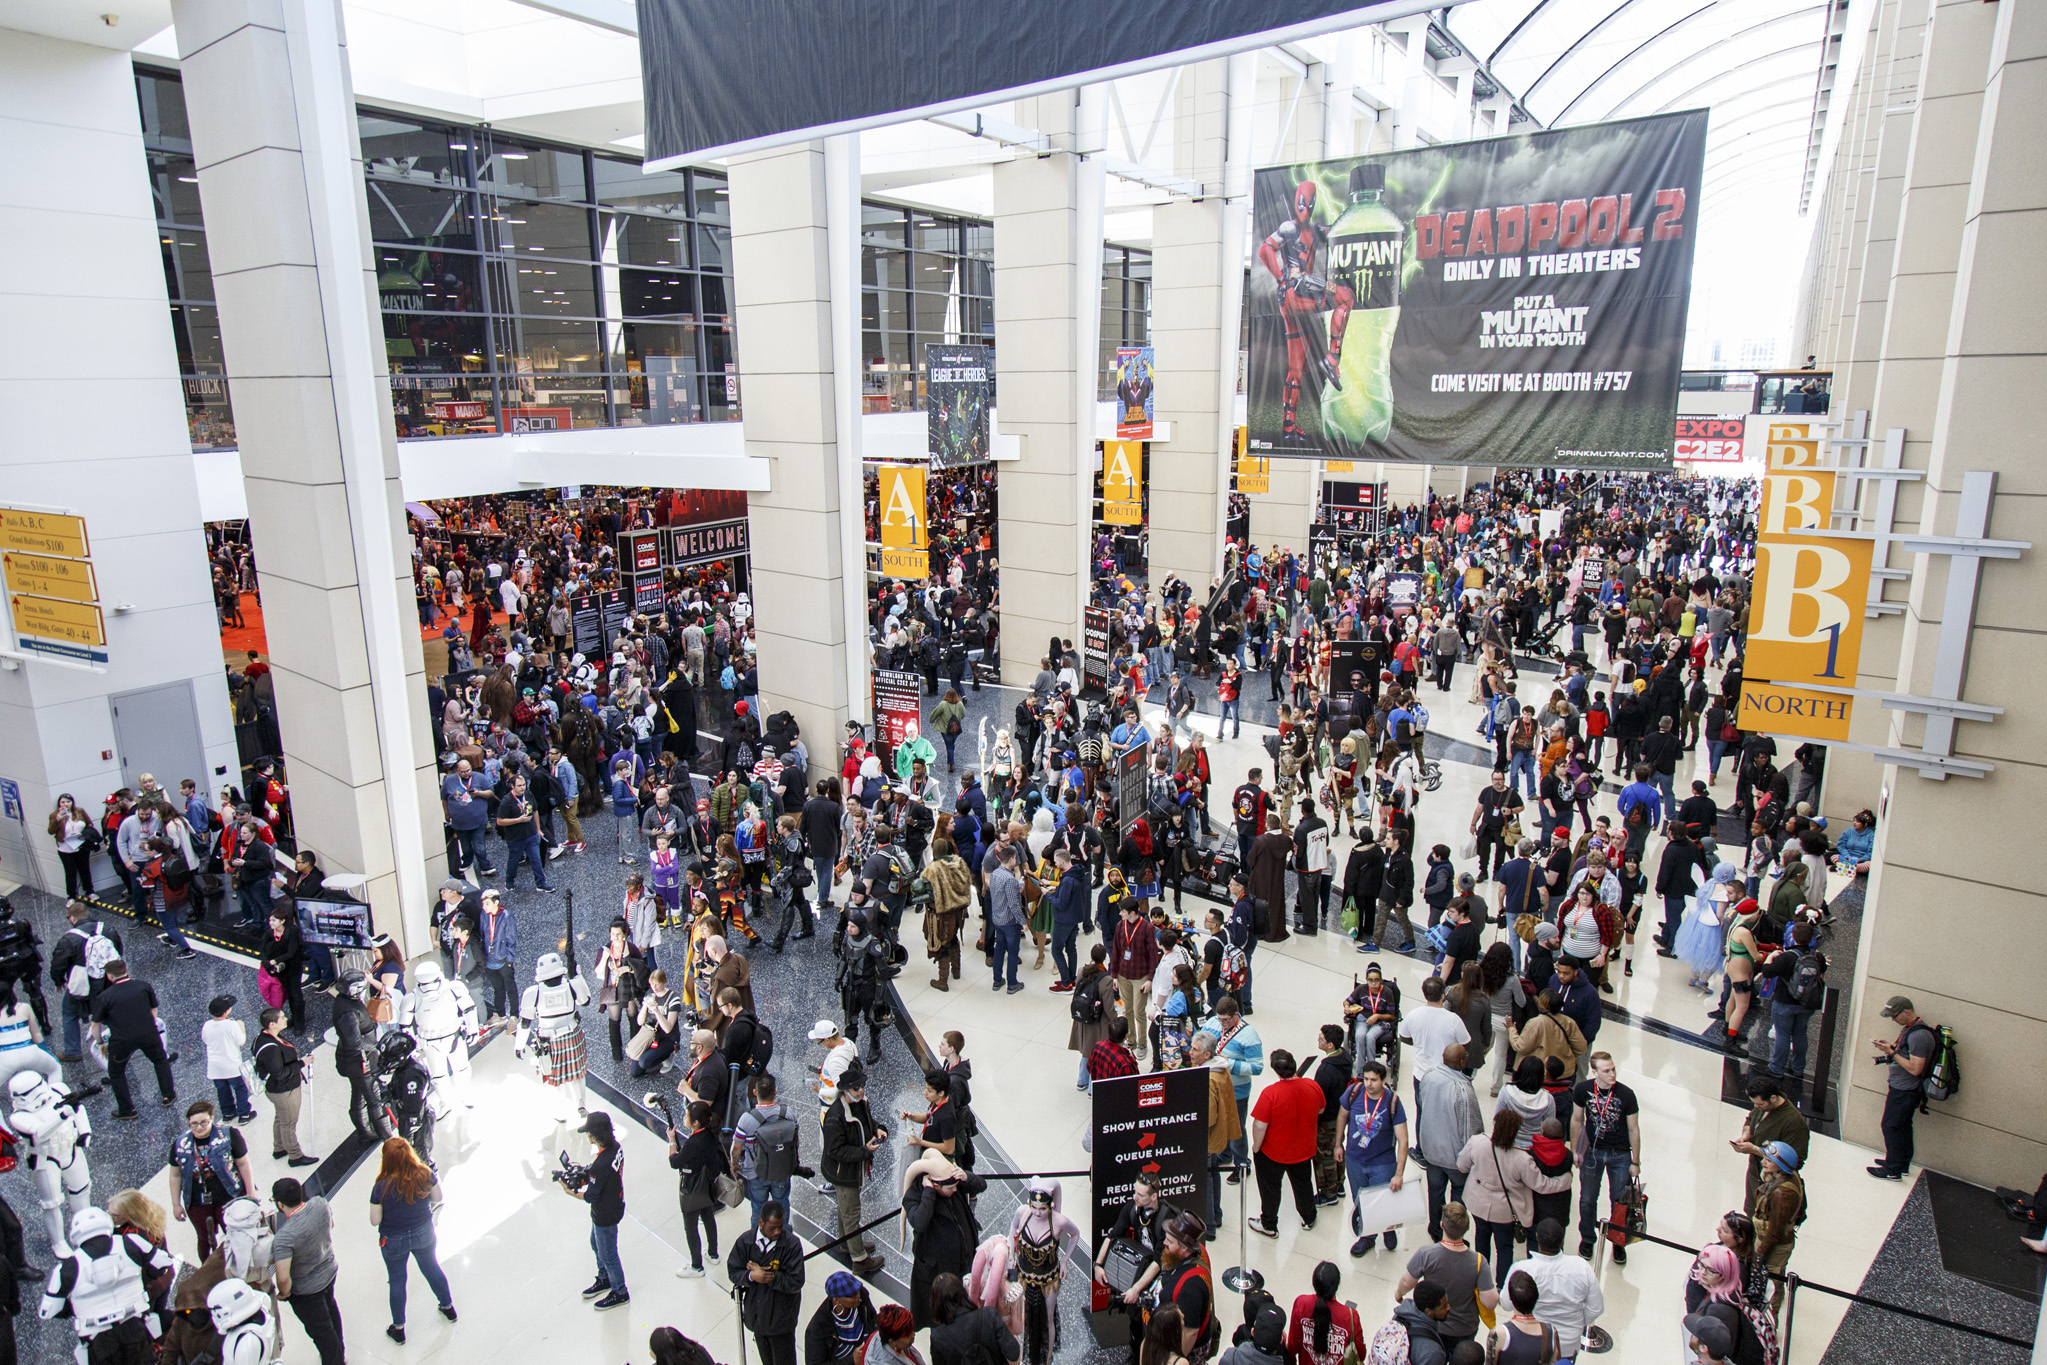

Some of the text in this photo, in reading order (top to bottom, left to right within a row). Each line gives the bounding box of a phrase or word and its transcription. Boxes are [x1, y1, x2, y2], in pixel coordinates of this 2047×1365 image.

[1416, 187, 1686, 259] DEADPOOL 2
[1328, 241, 1403, 268] MUTANT
[1444, 248, 1641, 281] ONLY IN THEATERS
[1514, 295, 1555, 310] PUT A
[1481, 306, 1590, 334] MUTANT
[1479, 331, 1587, 348] IN YOUR MOUTH
[931, 368, 953, 382] LEAGUE
[963, 367, 986, 382] HEROES
[1431, 371, 1633, 392] COME VISIT ME AT BOOTH #757
[189, 379, 221, 394] BLOCK
[455, 406, 484, 418] MARVEL
[1675, 420, 1743, 437] EXPO
[1557, 450, 1665, 459] DRINKMUTANT.COM
[1674, 440, 1740, 460] C2E2
[1239, 479, 1266, 487] SOUTH
[1105, 507, 1138, 516] SOUTH
[38, 518, 45, 529] C
[46, 540, 64, 552] S100
[637, 542, 656, 550] COMIC
[675, 525, 744, 556] WELCOME
[30, 560, 48, 571] S100
[55, 563, 69, 575] 106
[638, 558, 656, 567] C2E2
[884, 554, 923, 567] SOUTH
[43, 582, 48, 592] 4
[637, 588, 662, 602] COMICS
[638, 599, 657, 607] COSPLAY
[66, 626, 75, 638] 40
[81, 629, 91, 640] 44
[1085, 628, 1107, 640] COSPLAY
[1085, 647, 1108, 660] CONSENT
[875, 677, 895, 685] OFFICIAL
[880, 671, 903, 680] DOWNLOAD
[1743, 692, 1847, 721] NORTH
[1125, 781, 1143, 805] AFTER
[1140, 1082, 1163, 1090] COMIC
[1140, 1091, 1163, 1099] EXPO
[1140, 1096, 1163, 1106] C2E2
[1102, 1112, 1197, 1134] SHOW ENTRANCE
[1115, 1145, 1184, 1164] QUEUE HALL
[1158, 1184, 1196, 1198] ICKETS
